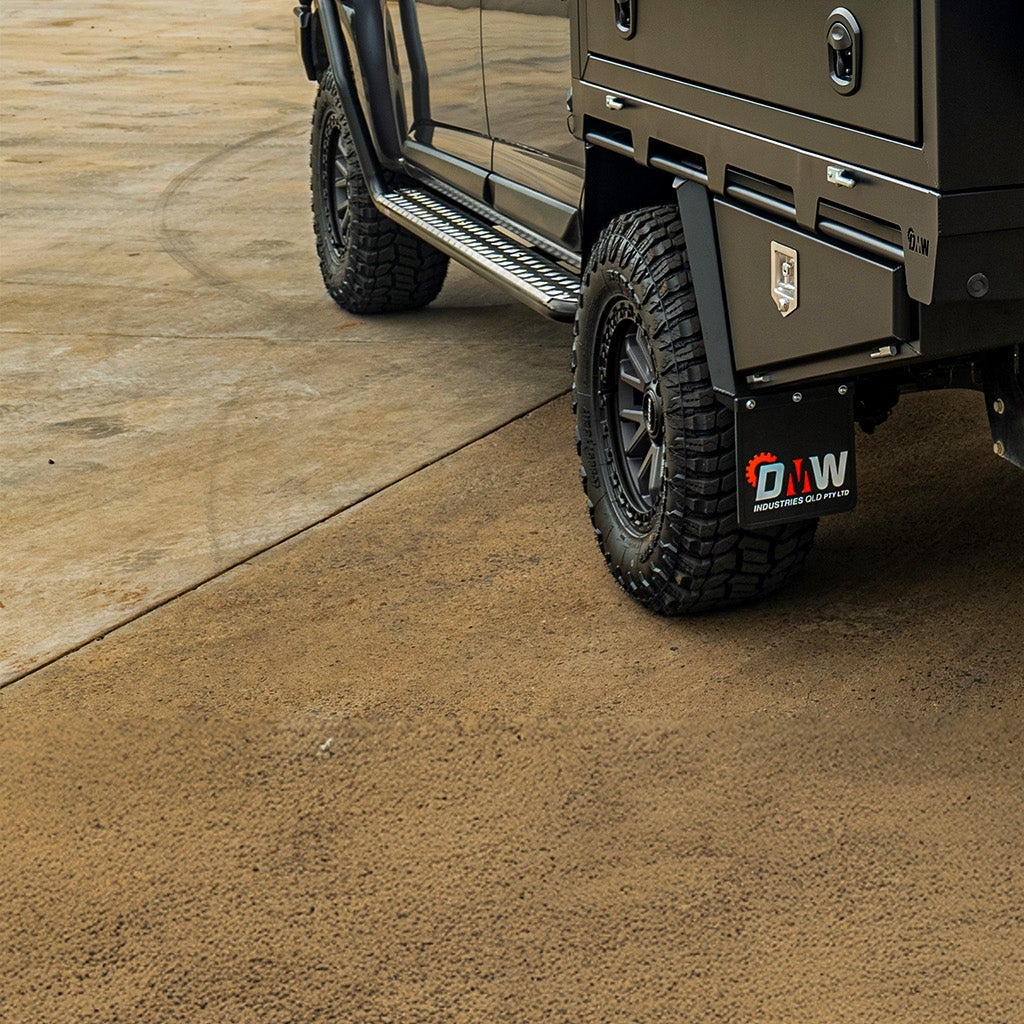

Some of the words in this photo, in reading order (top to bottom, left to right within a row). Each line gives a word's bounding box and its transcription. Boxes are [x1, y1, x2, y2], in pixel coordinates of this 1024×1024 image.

[751, 451, 848, 502] DMW
[753, 496, 804, 512] INDUSTRIES
[804, 494, 823, 503] QLD
[823, 492, 837, 500] PTY
[836, 489, 850, 497] LTD
